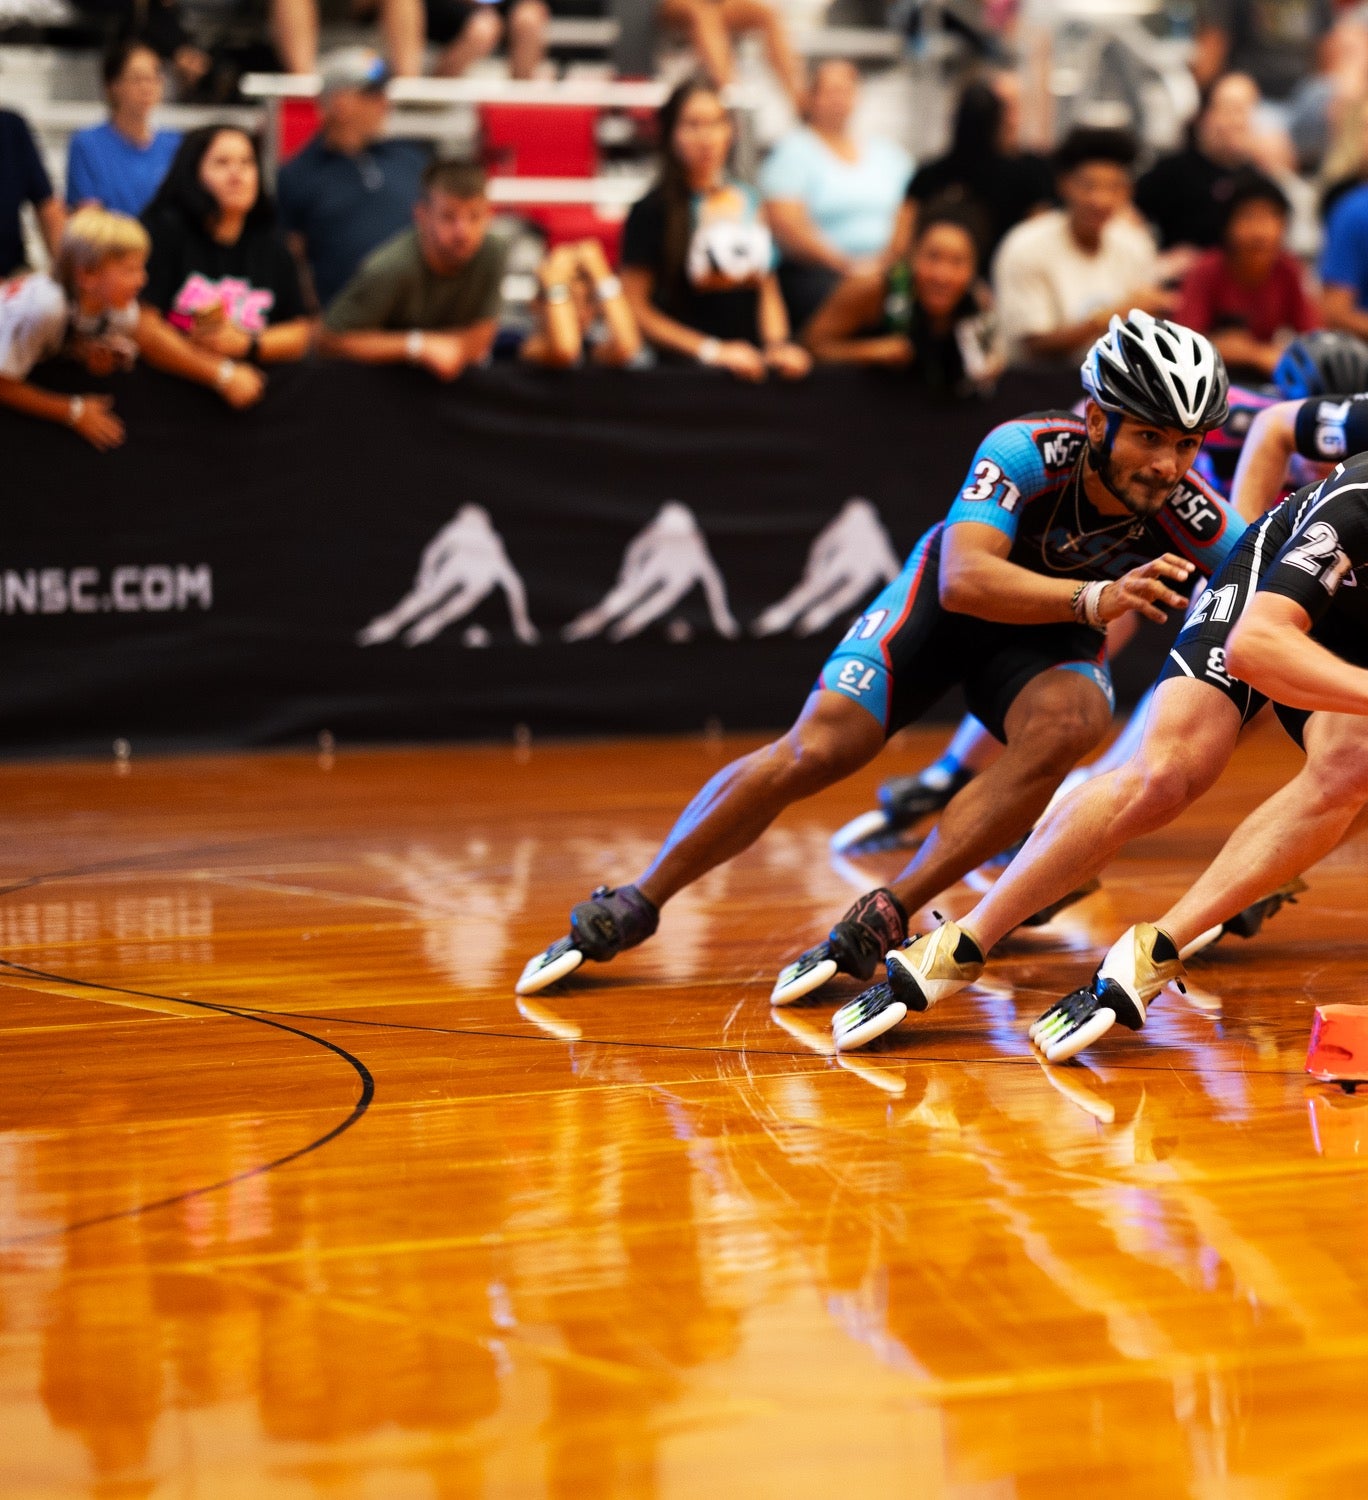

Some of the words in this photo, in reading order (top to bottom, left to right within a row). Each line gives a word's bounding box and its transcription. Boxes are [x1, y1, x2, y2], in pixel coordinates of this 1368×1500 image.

[961, 458, 1022, 513] 31
[1168, 482, 1217, 531] NSC
[1280, 521, 1353, 596] 21
[0, 562, 213, 615] NSC.COM
[1180, 584, 1238, 633] 21
